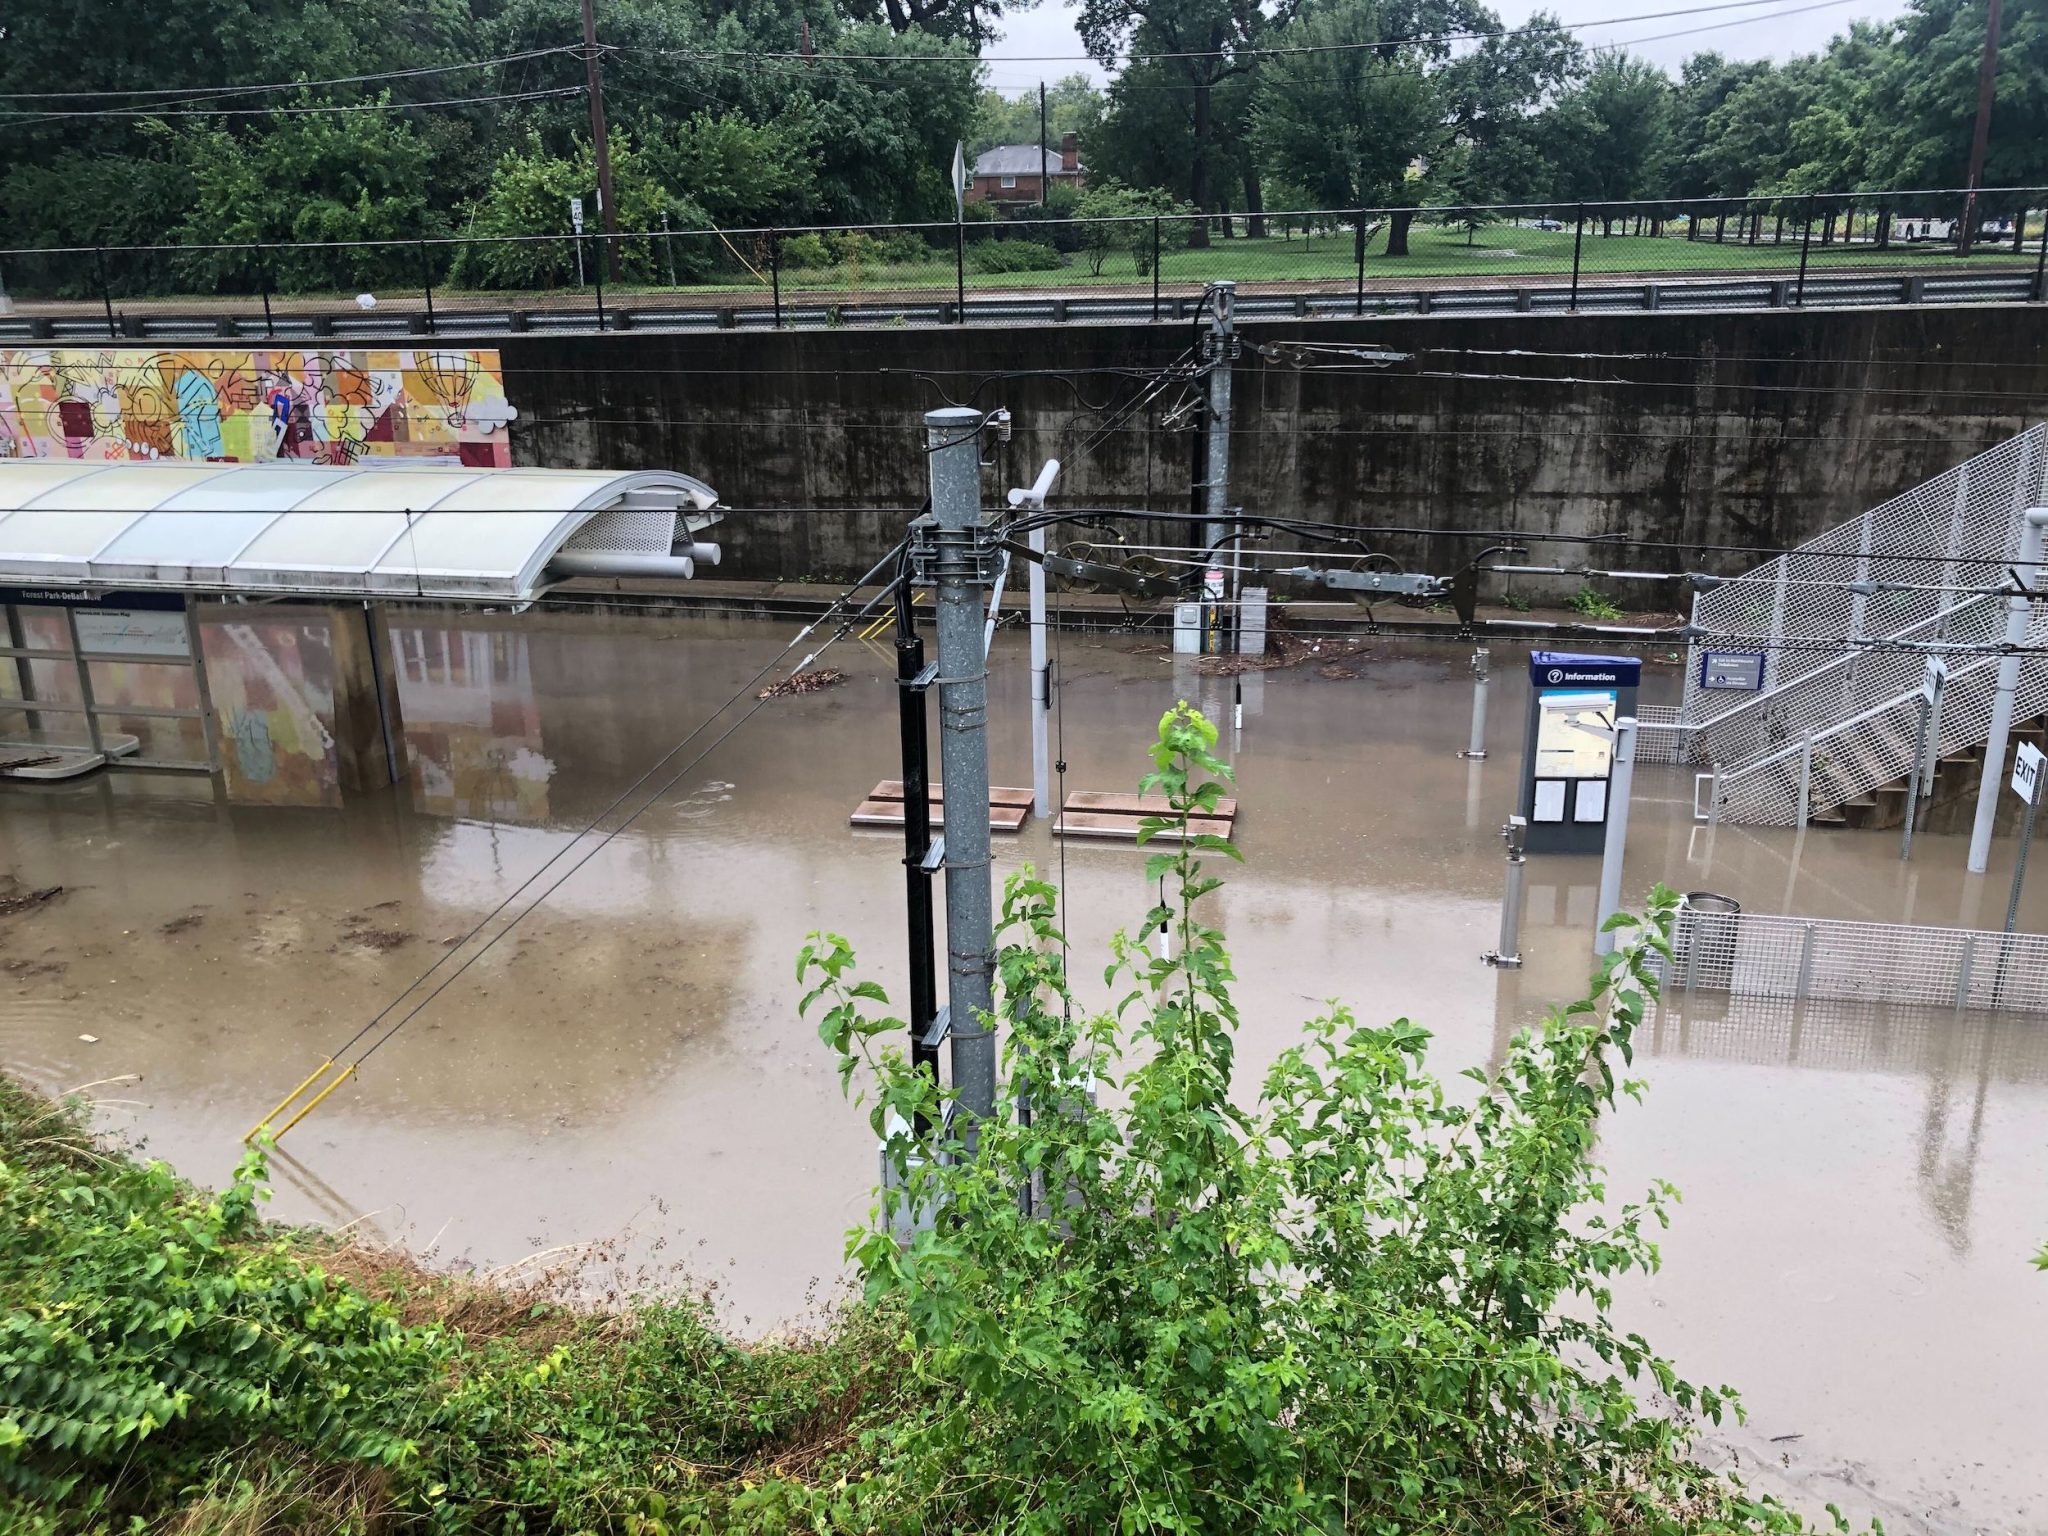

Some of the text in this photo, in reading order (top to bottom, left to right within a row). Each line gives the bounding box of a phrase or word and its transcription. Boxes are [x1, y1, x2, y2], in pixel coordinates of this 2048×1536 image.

[573, 211, 582, 221] 40
[22, 590, 44, 599] Forest
[1564, 672, 1616, 681] Information
[2015, 755, 2036, 787] EXIT
